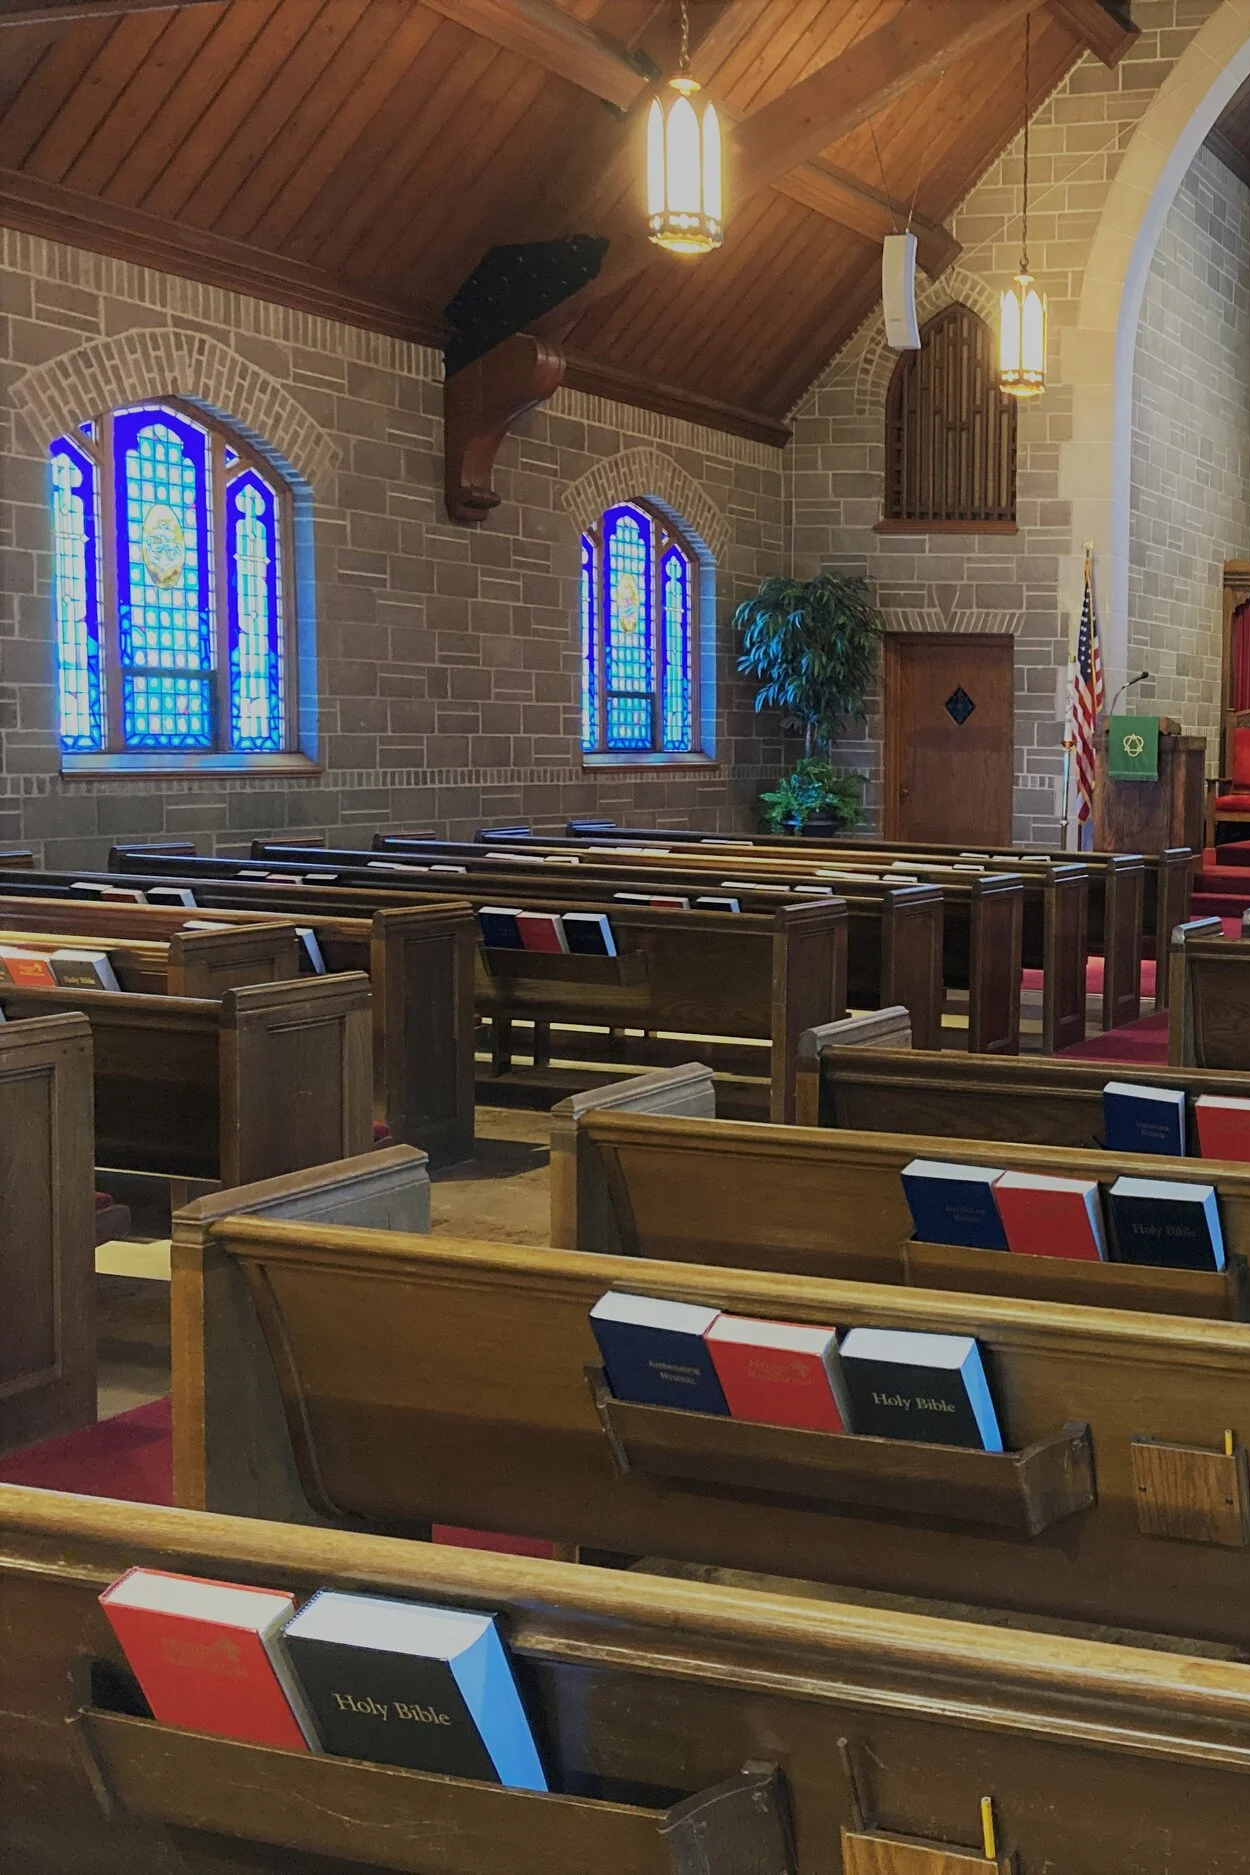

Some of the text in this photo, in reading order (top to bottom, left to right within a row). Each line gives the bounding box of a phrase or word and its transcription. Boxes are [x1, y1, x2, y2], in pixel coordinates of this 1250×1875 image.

[1131, 1223, 1198, 1238] Holy Bible
[871, 1392, 956, 1413] Holy Bible
[332, 1692, 451, 1726] Holy Bible
